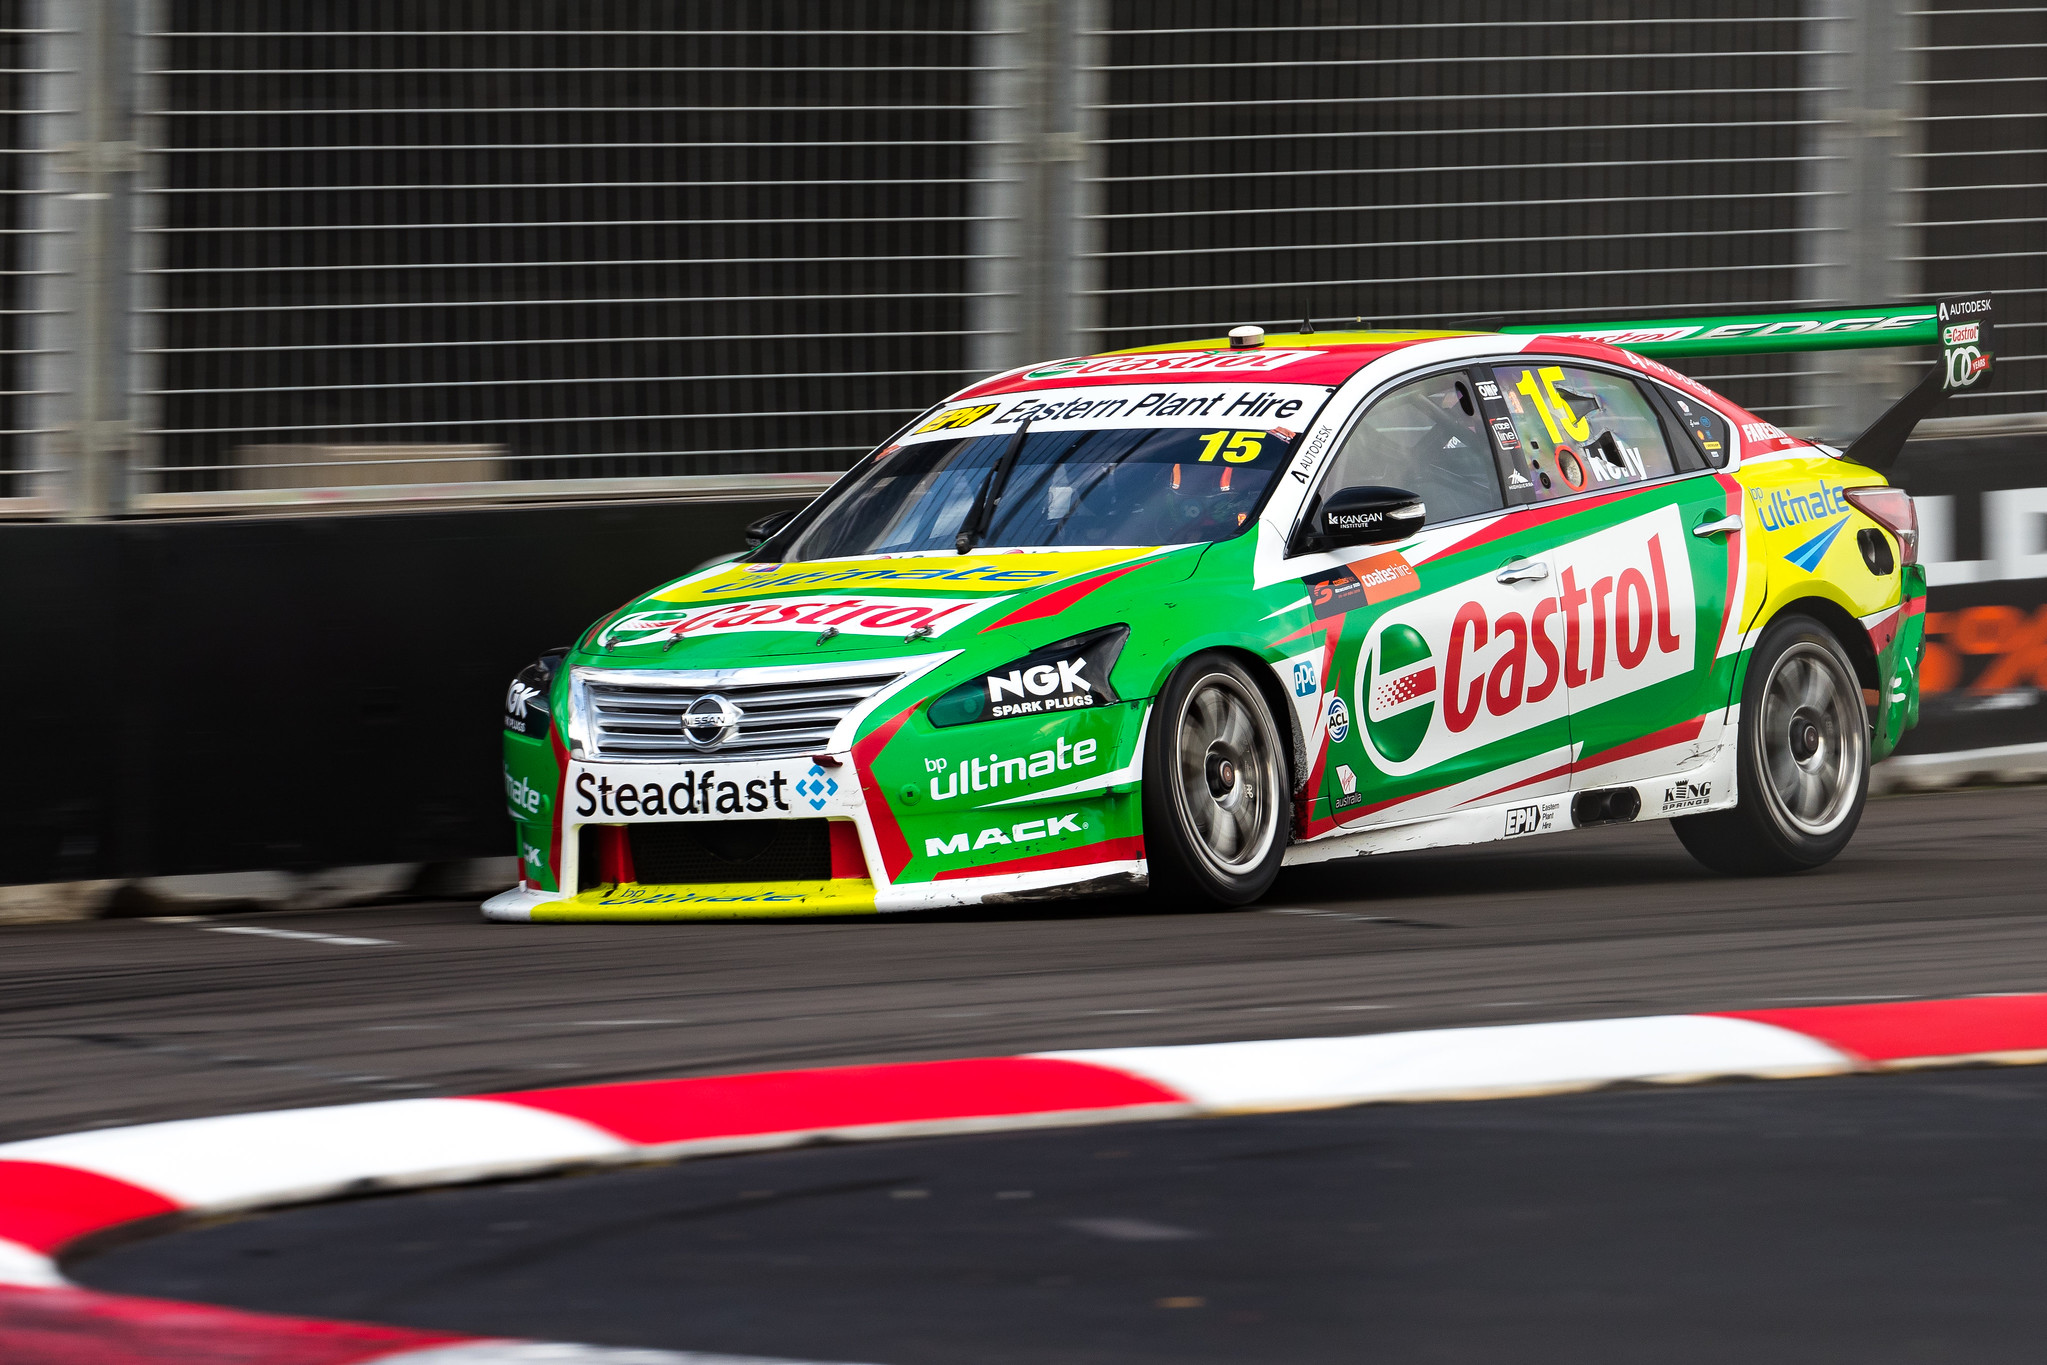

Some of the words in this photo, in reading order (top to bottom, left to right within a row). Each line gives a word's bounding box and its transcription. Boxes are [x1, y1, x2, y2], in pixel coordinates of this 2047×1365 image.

[1950, 299, 1992, 315] AUTODESK
[1952, 325, 1977, 342] Castrol
[1076, 352, 1299, 374] Castrol
[1943, 345, 1982, 389] 100
[1972, 358, 1986, 371] YEARS
[1478, 384, 1499, 397] OMP
[1645, 358, 1719, 401] AUTODESK
[991, 396, 1129, 425] Eastern
[1123, 392, 1227, 418] Plant
[1221, 392, 1303, 419] Hire
[1515, 366, 1590, 444] 15
[1198, 430, 1268, 464] 15
[1299, 424, 1334, 472] AUTODESK
[1340, 512, 1383, 524] KANGAN
[1758, 479, 1850, 532] ultimate
[701, 566, 1060, 594] ultimate
[670, 600, 976, 635] Castrol
[1442, 532, 1680, 734] Castrol
[987, 657, 1092, 703] NGK
[1294, 664, 1316, 694] PPG
[992, 700, 1043, 717] SPARK
[1045, 694, 1094, 711] PLUGS
[684, 715, 726, 727] NISSAN
[1328, 712, 1349, 730] ACL
[924, 757, 948, 773] bp
[929, 736, 1097, 801] ultimate
[575, 769, 790, 817] Steadfast
[1335, 792, 1362, 810] australia
[1662, 798, 1710, 812] SPRINGS
[1541, 802, 1560, 812] Eastern
[1541, 812, 1555, 821] Plant
[1506, 805, 1537, 836] EPH
[1541, 821, 1552, 830] Hire
